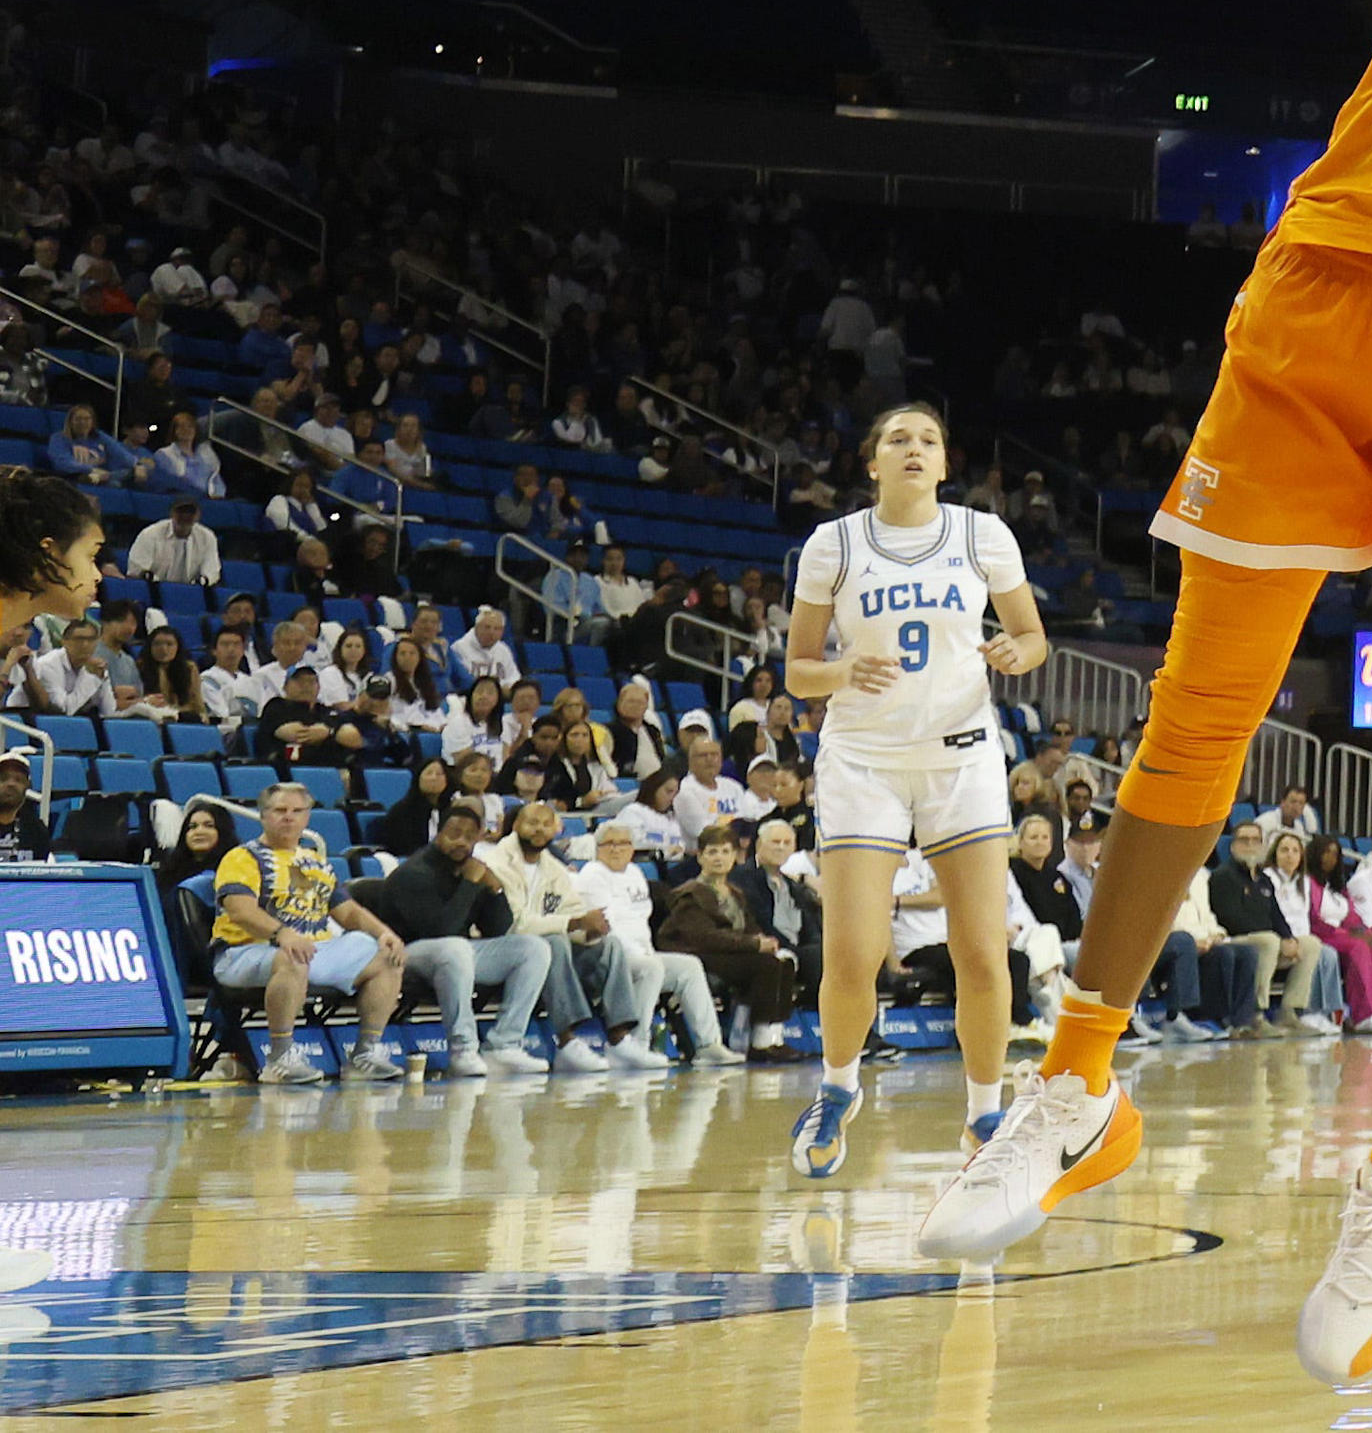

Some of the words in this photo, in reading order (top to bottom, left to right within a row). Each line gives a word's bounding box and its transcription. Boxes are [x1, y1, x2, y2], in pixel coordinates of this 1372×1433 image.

[1175, 93, 1209, 112] EXIT
[859, 582, 966, 619] UCLA
[897, 620, 930, 673] 9
[5, 929, 148, 984] RISING
